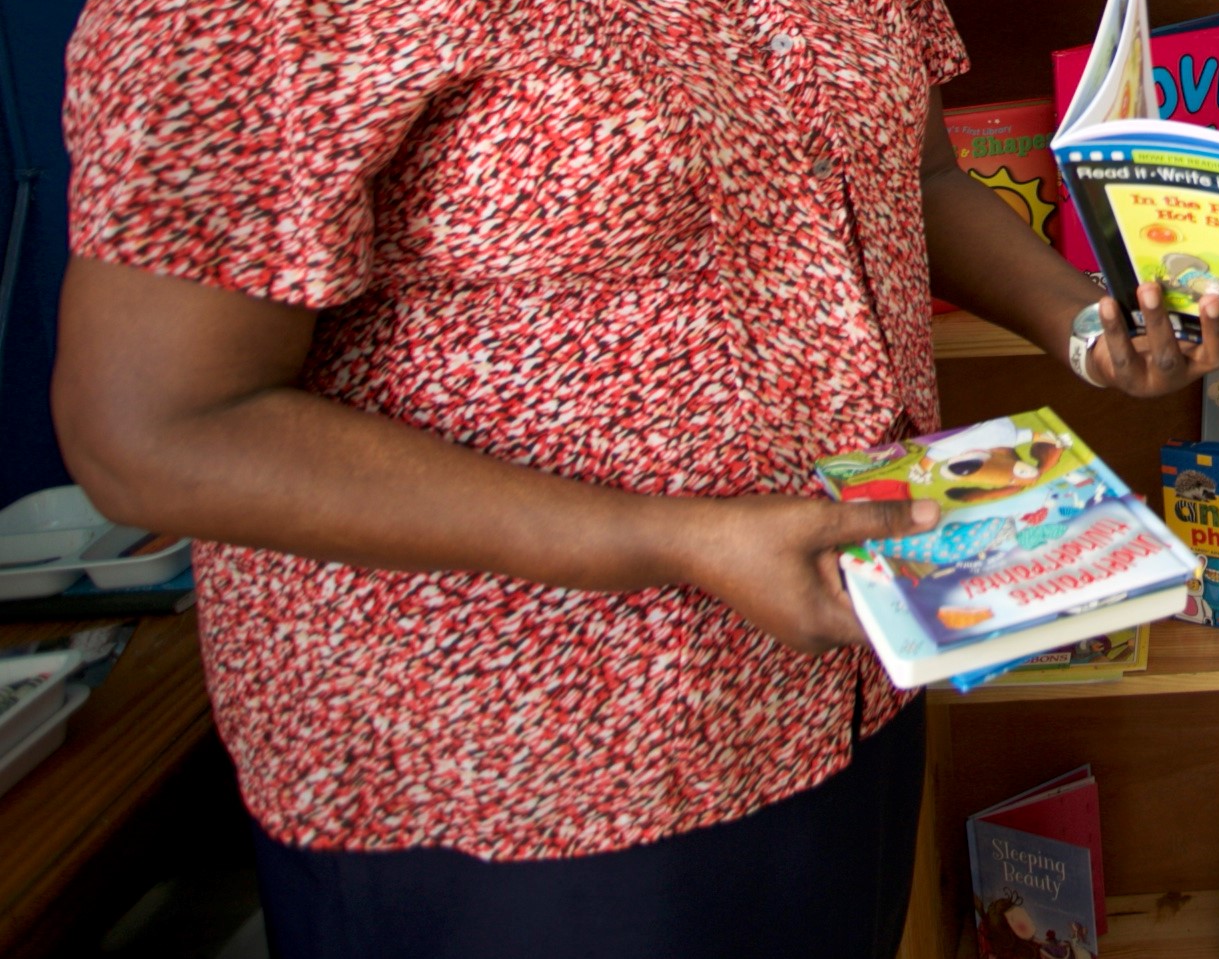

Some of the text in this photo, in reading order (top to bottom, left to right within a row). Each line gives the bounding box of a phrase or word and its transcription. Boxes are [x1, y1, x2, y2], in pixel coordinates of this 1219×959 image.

[962, 125, 1012, 136] First Library
[960, 148, 970, 158] &
[1076, 166, 1131, 180] Read
[1157, 167, 1213, 189] Write
[1130, 194, 1156, 206] In
[1163, 196, 1202, 211] the
[1156, 209, 1197, 224] Hot
[991, 837, 1067, 882] Sleeping
[1003, 861, 1062, 901] Beauty
